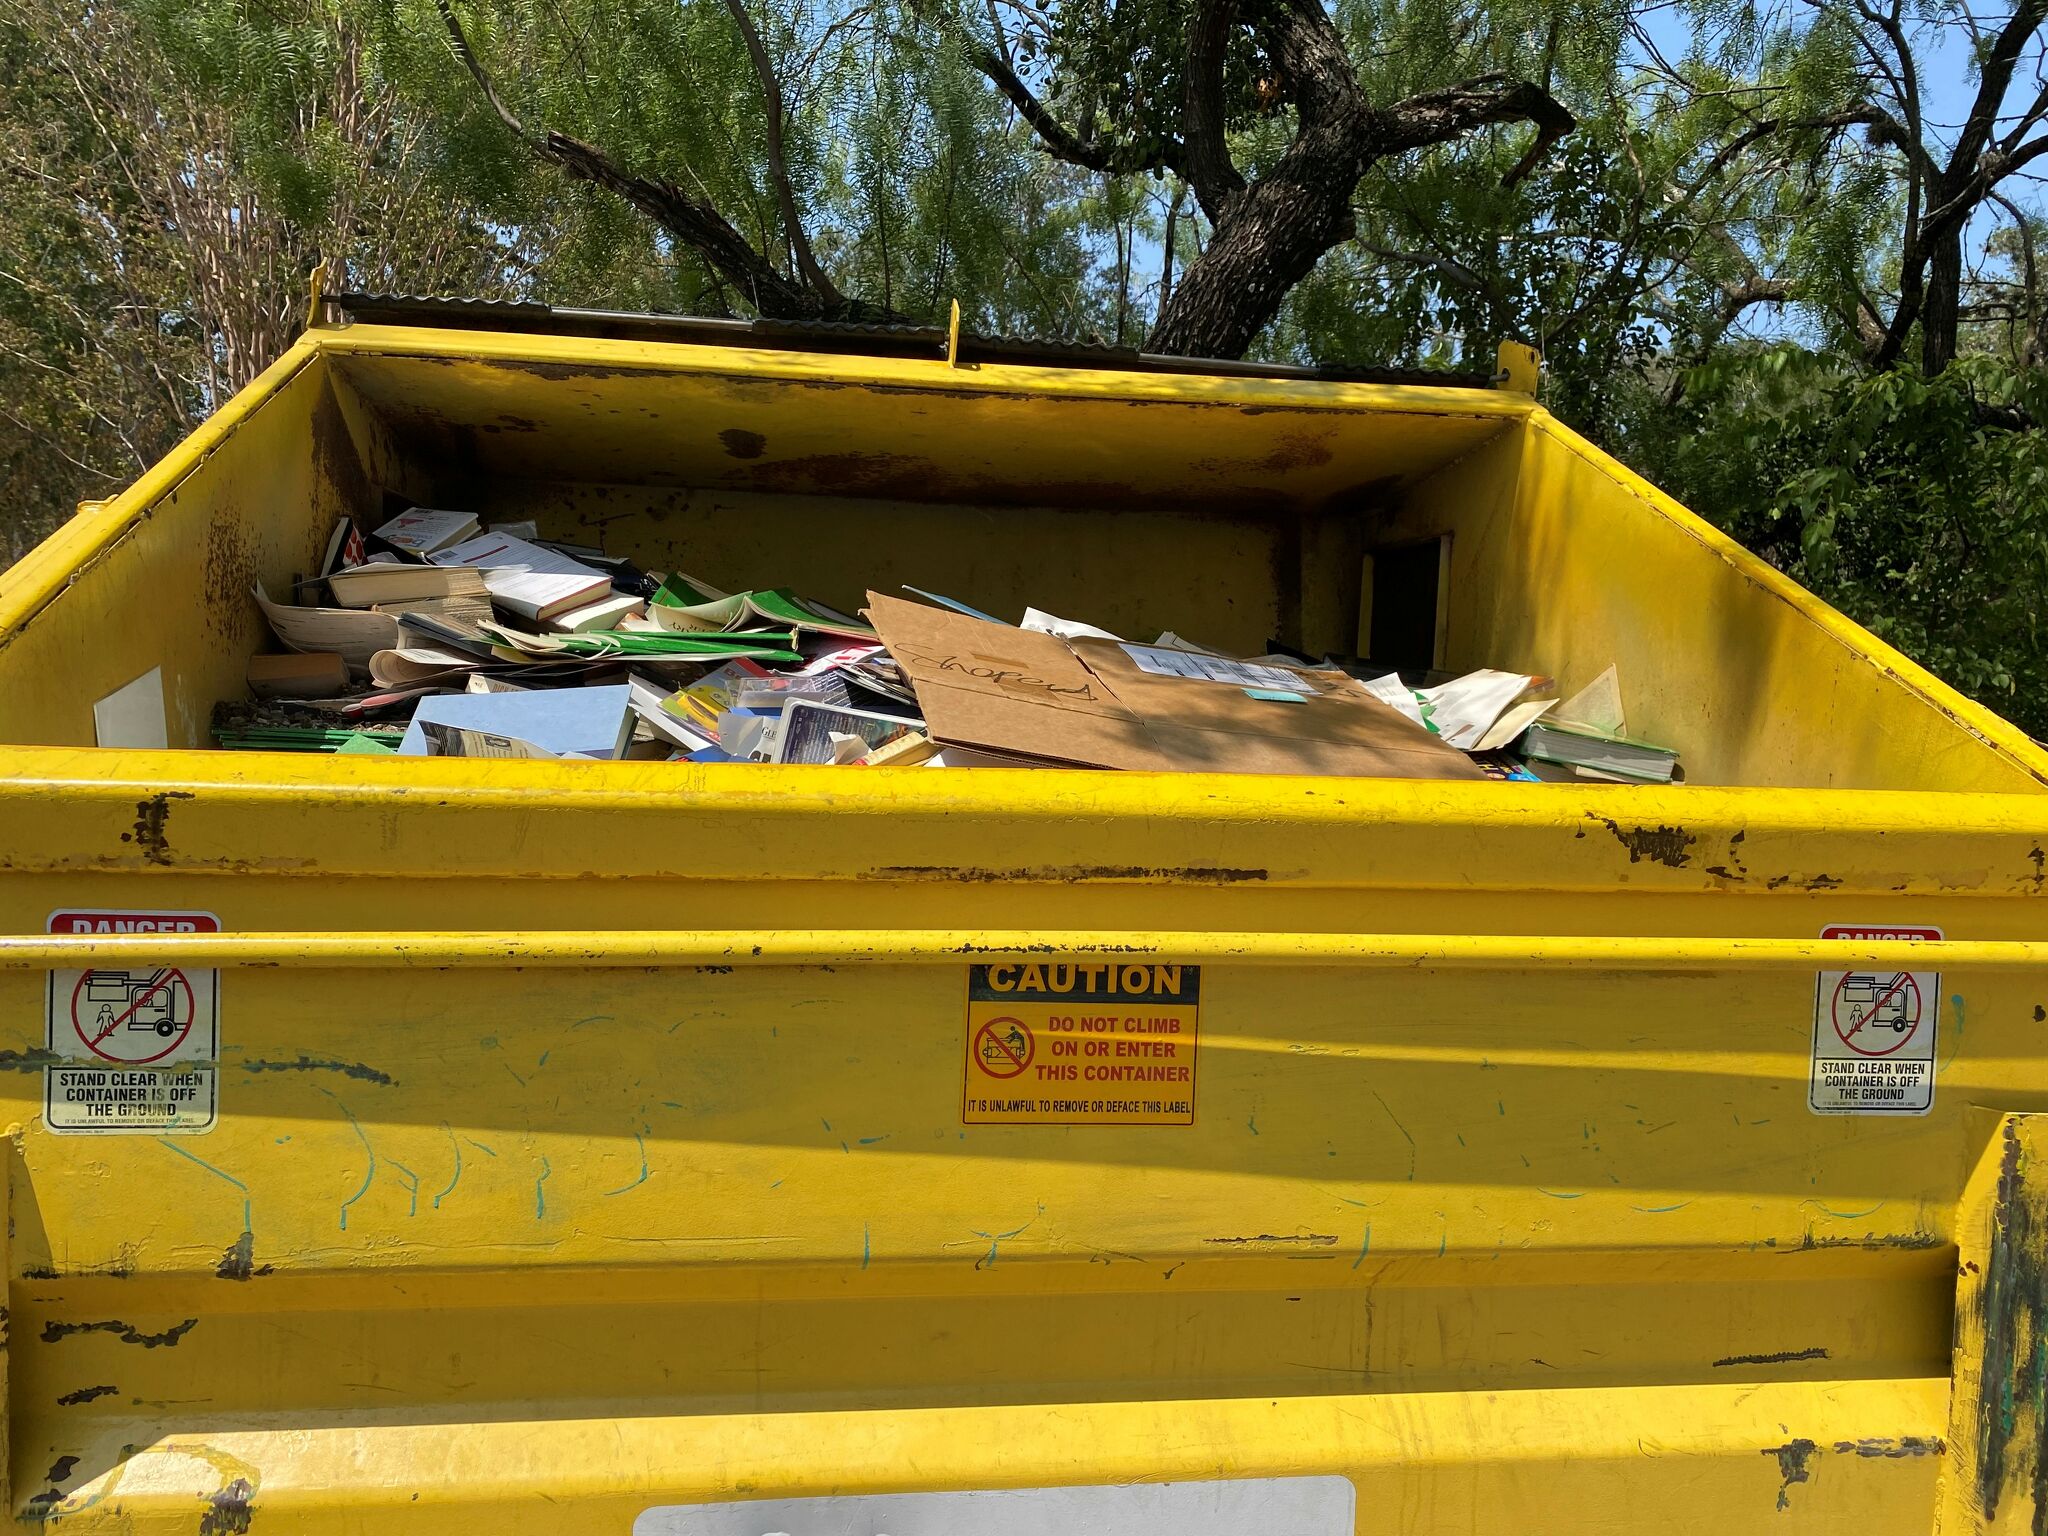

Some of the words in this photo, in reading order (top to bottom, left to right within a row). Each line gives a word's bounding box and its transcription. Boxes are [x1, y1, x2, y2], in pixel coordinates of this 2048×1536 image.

[988, 964, 1182, 994] CAUTION
[1048, 1016, 1074, 1032] DO
[1080, 1017, 1118, 1032] NOT
[1124, 1018, 1181, 1034] CLIMB
[1052, 1041, 1080, 1056] ON
[1084, 1042, 1110, 1056] OR
[1116, 1042, 1176, 1058] ENTER
[1035, 1064, 1078, 1080] THIS
[1084, 1065, 1190, 1082] CONTAINER
[1821, 1062, 1854, 1074] STAND
[1858, 1062, 1891, 1074] CLEAR
[1895, 1063, 1925, 1074] WHEN
[60, 1072, 107, 1086] STAND
[112, 1072, 156, 1086] CLEAR
[162, 1073, 203, 1086] WHEN
[1825, 1076, 1884, 1087] CONTAINER
[1886, 1076, 1897, 1087] IS
[1900, 1076, 1920, 1088] OFF
[66, 1088, 147, 1102] CONTAINER
[151, 1088, 166, 1101] IS
[170, 1088, 196, 1101] OFF
[1839, 1088, 1858, 1100] THE
[1862, 1088, 1904, 1100] GROUND
[86, 1103, 114, 1116] THE
[118, 1103, 176, 1116] GROUND
[968, 1100, 977, 1112] IT
[978, 1100, 987, 1112] IS
[989, 1100, 1036, 1112] UNLAWFUL
[1039, 1100, 1050, 1112] TO
[1053, 1100, 1088, 1112] REMOVE
[1092, 1100, 1103, 1113] OR
[1106, 1100, 1141, 1113] DEFACE
[1142, 1100, 1161, 1113] THIS
[1164, 1101, 1190, 1113] LABEL
